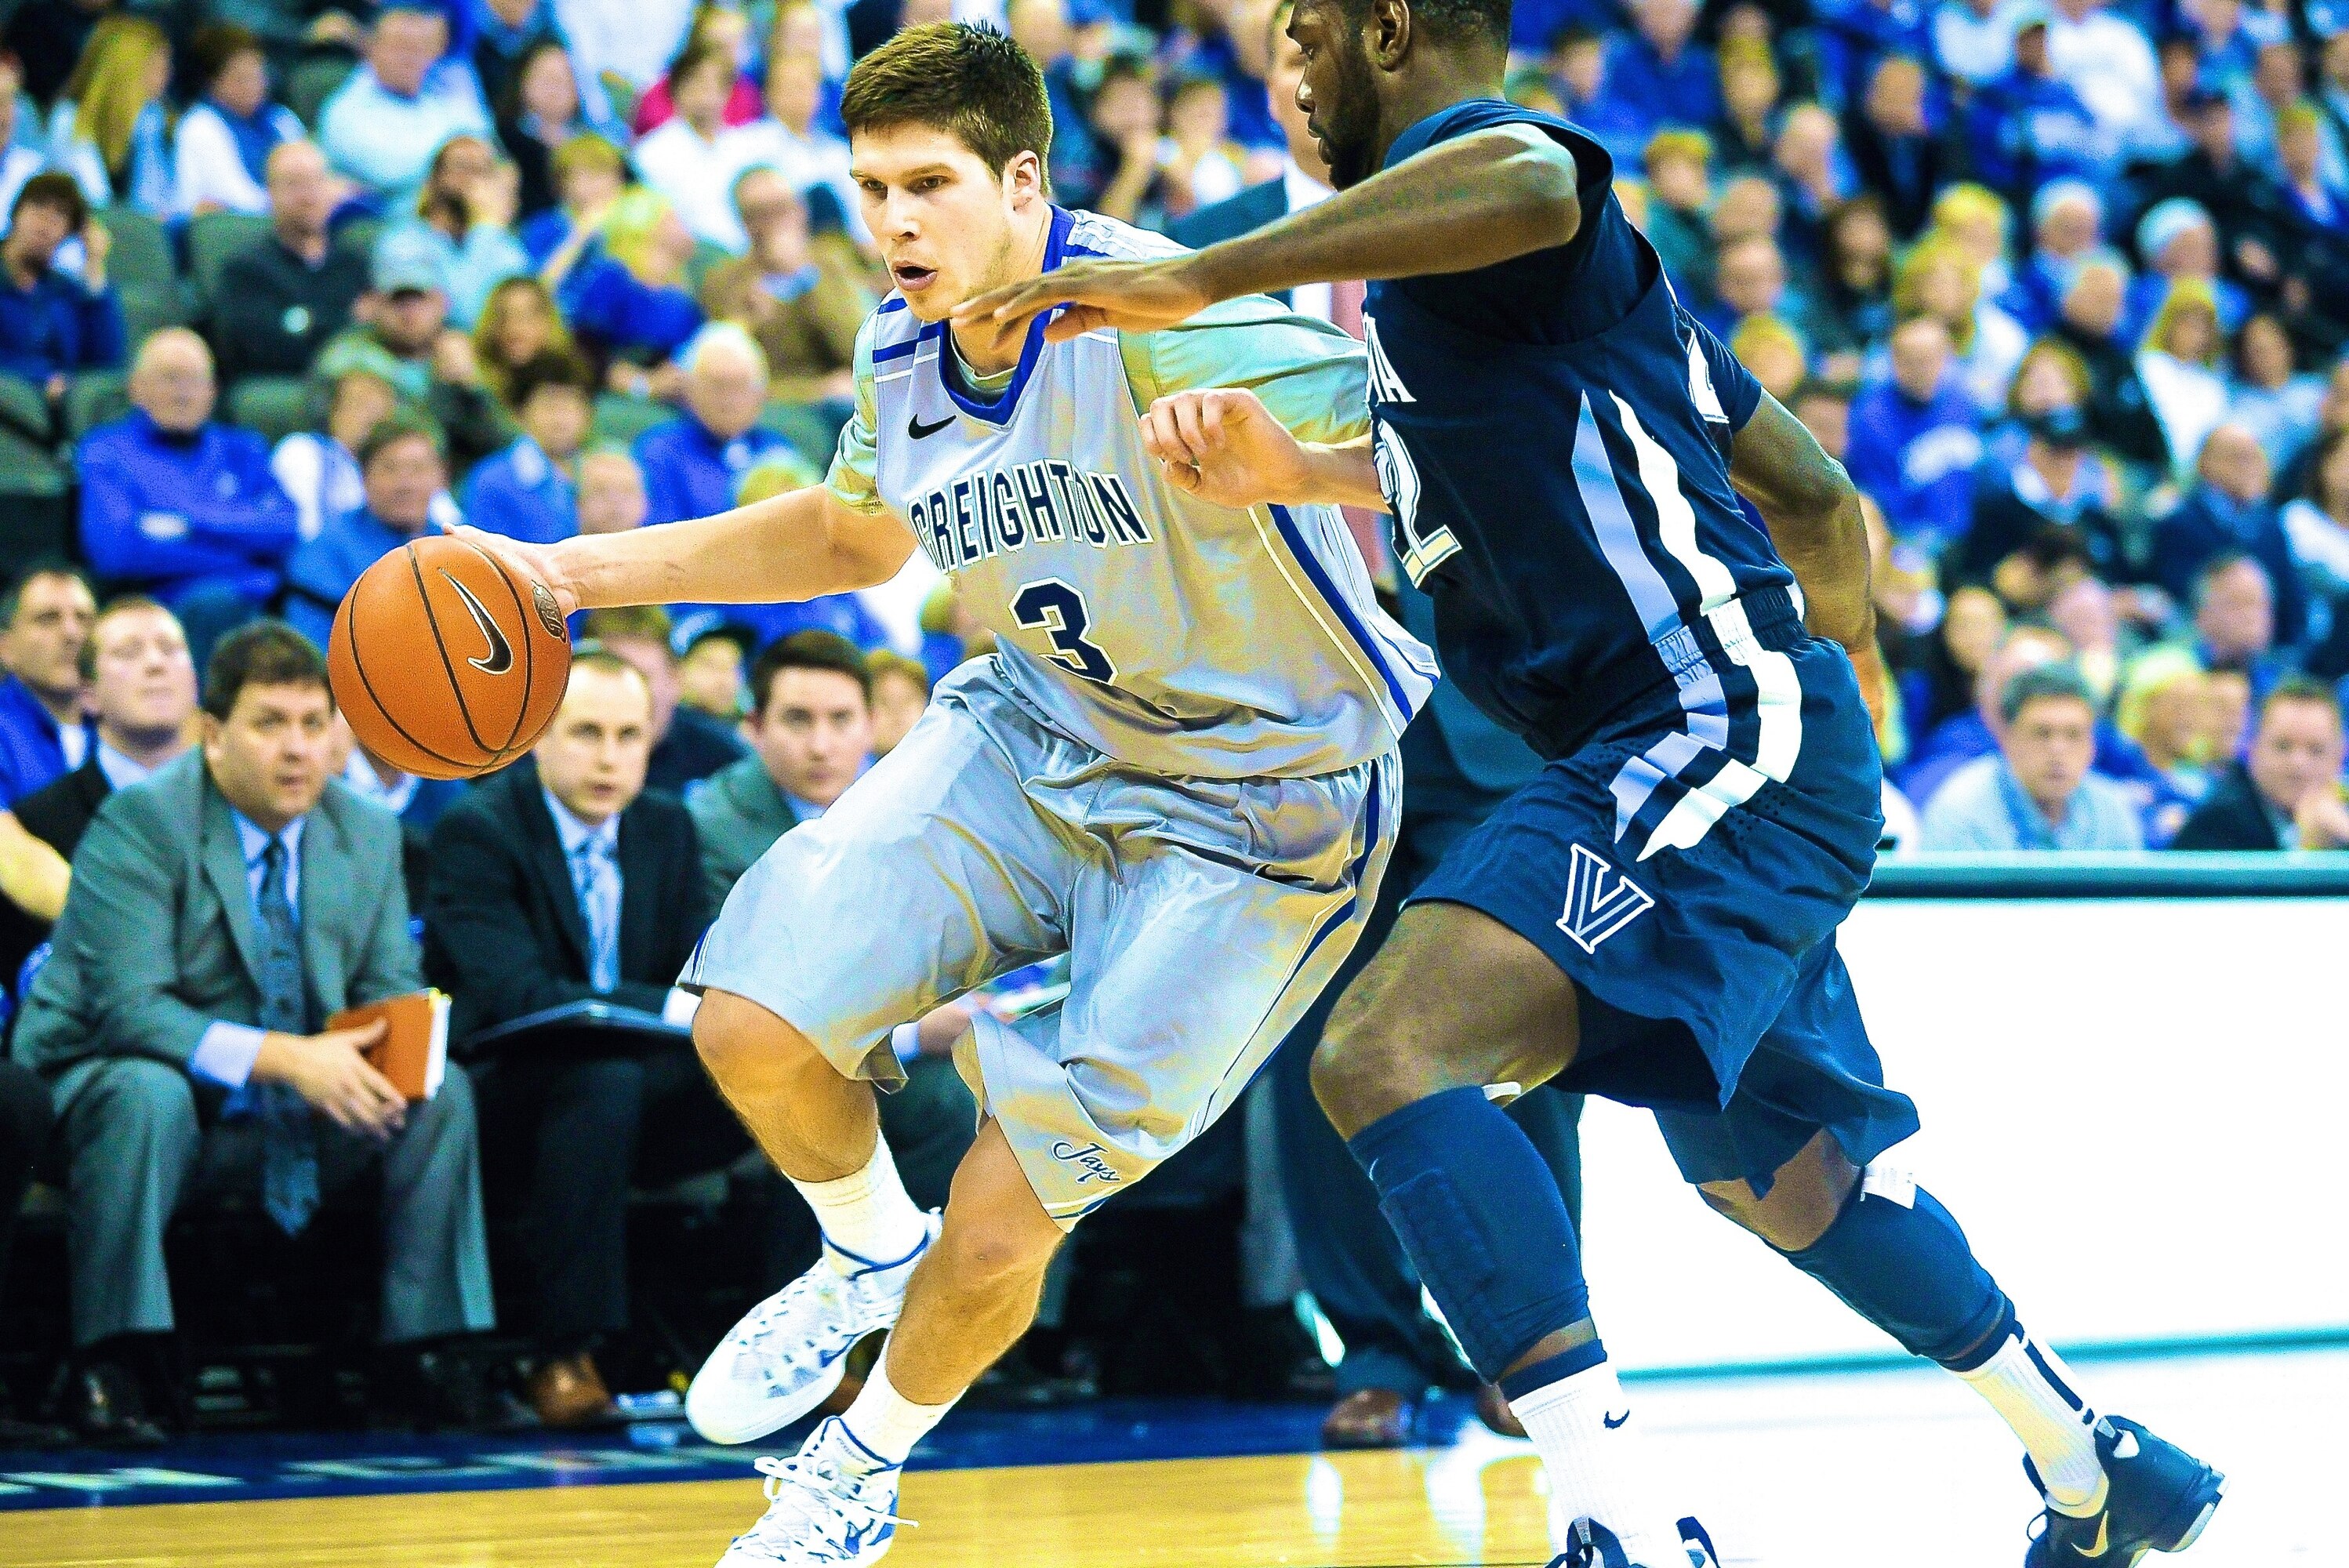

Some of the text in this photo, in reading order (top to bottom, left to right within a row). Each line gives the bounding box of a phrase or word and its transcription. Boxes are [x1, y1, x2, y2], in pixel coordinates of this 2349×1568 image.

[907, 457, 1154, 575] CREIGHTON
[1007, 576, 1119, 686] 3
[1556, 843, 1655, 954] V
[1051, 1140, 1121, 1185] Jays
